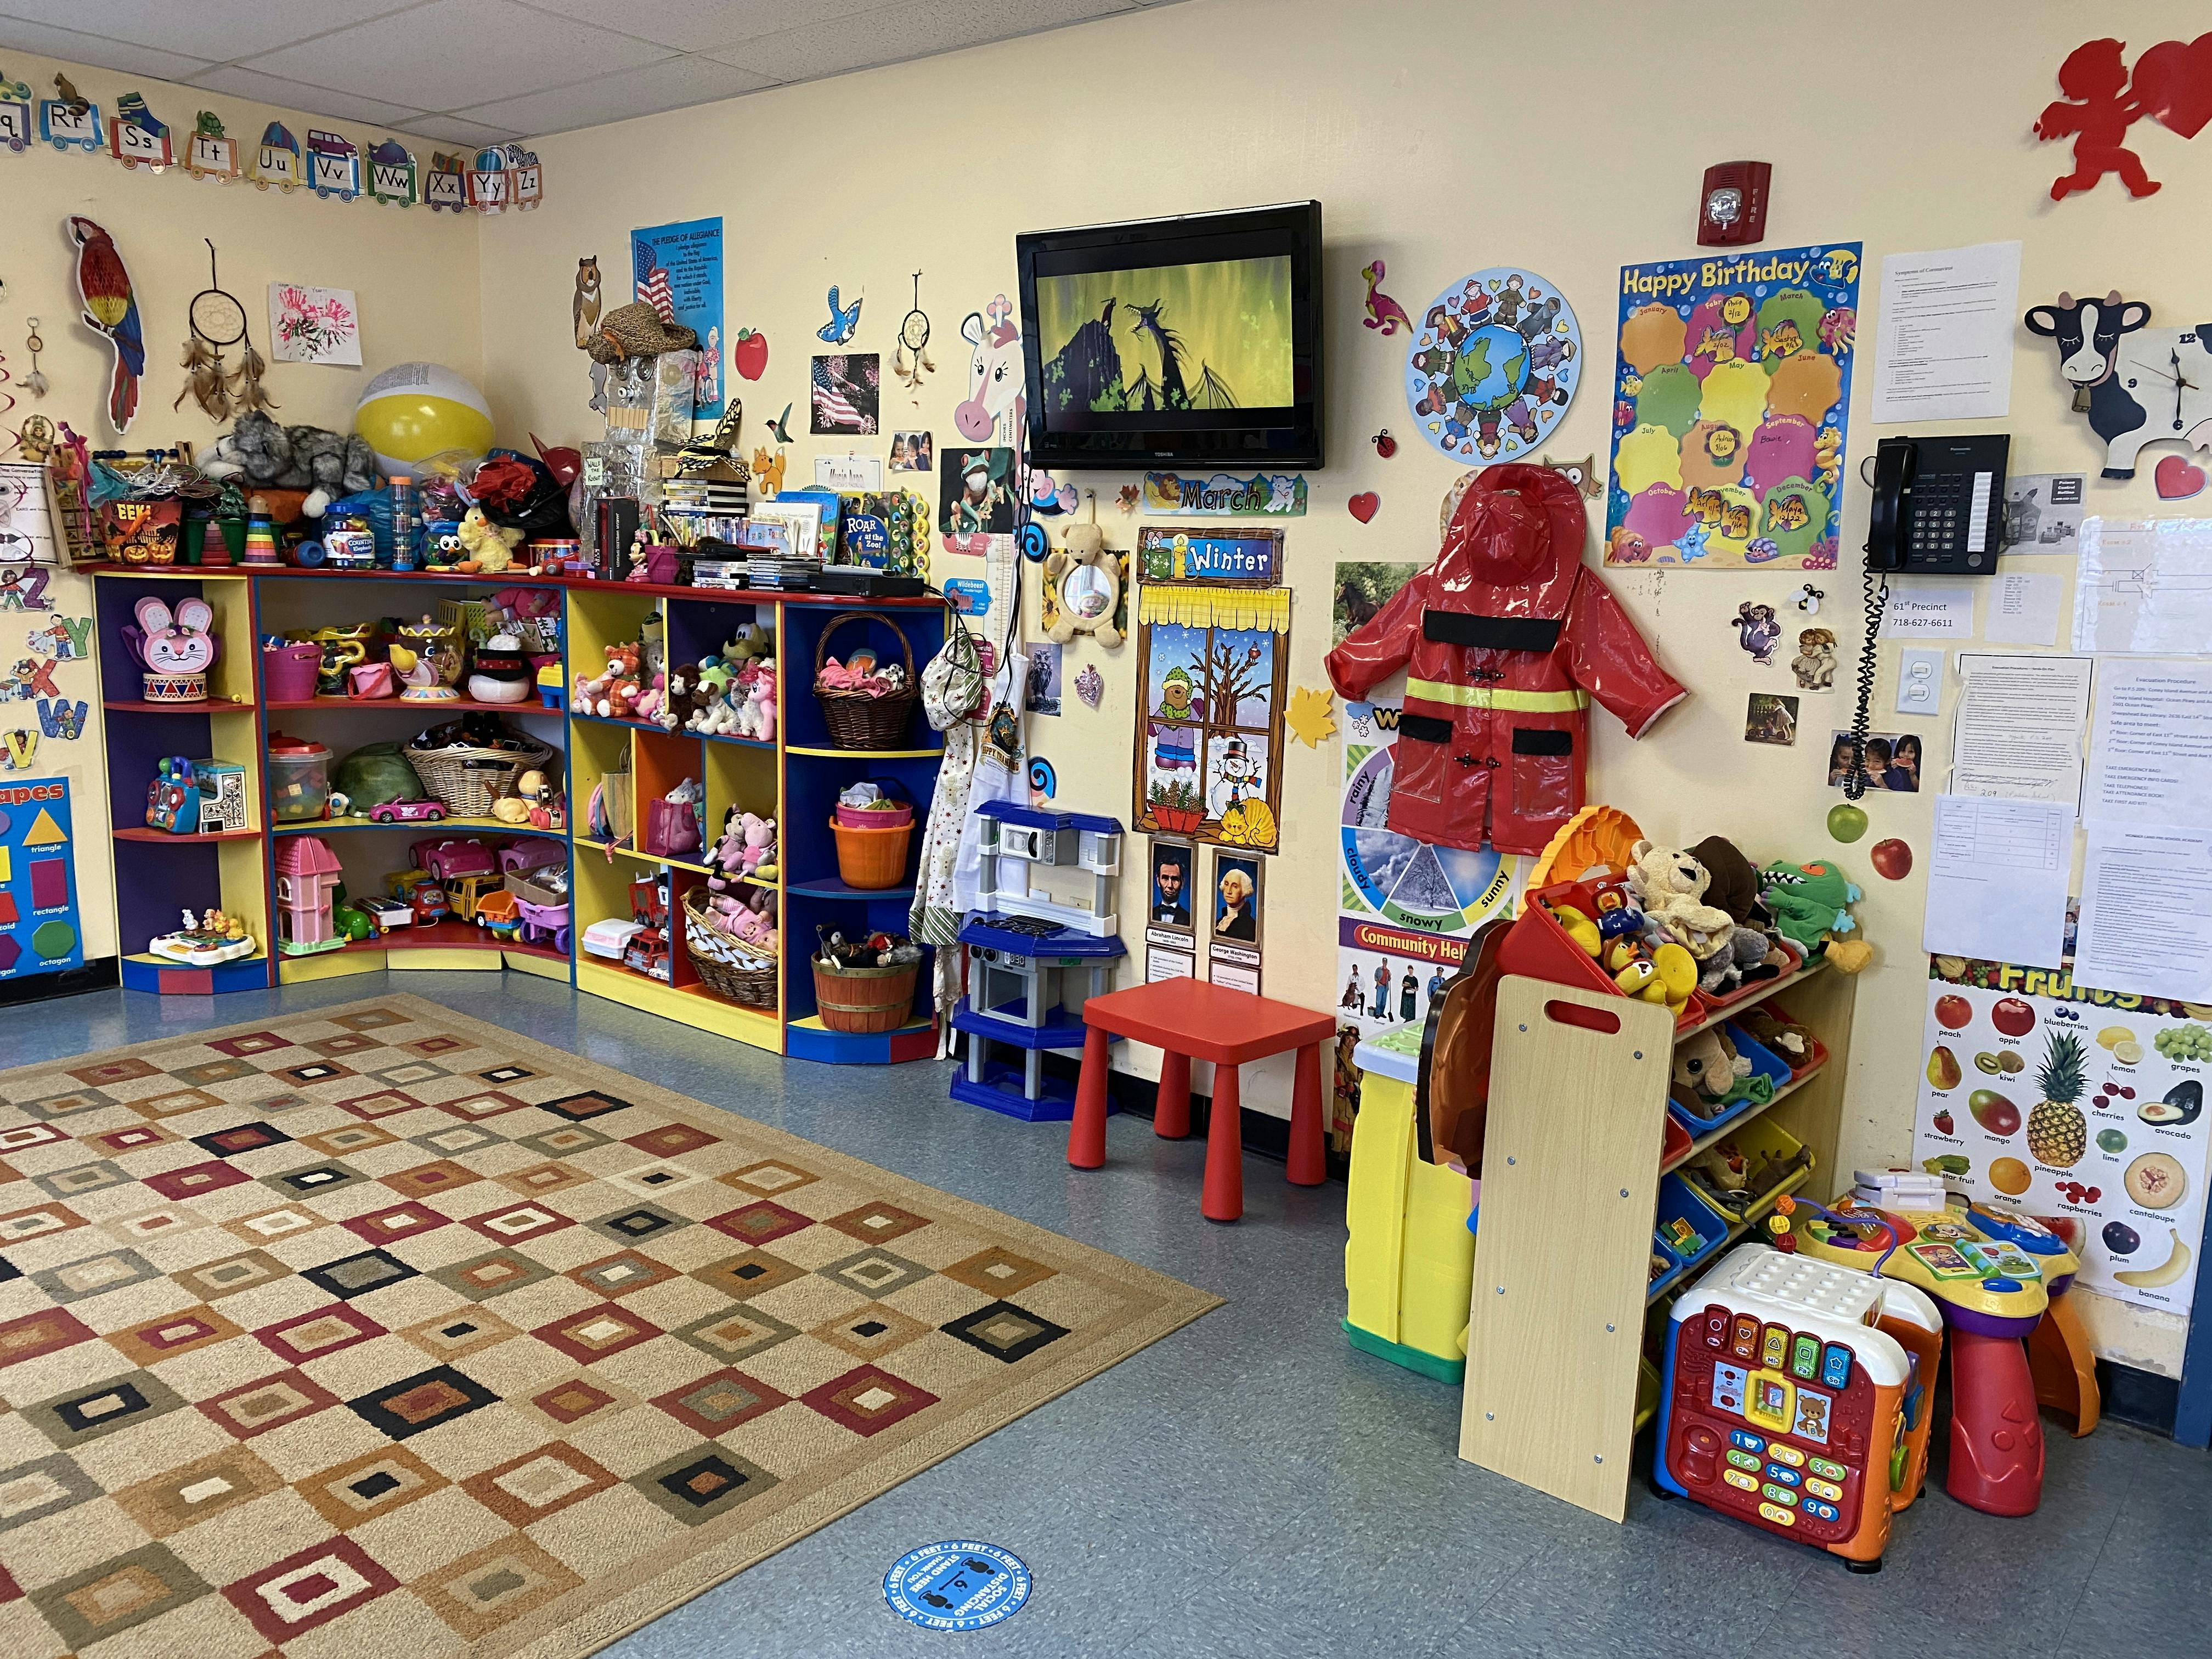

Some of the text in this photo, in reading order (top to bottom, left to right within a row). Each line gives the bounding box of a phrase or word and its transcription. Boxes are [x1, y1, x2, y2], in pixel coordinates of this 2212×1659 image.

[51, 104, 82, 129] Rr
[125, 126, 152, 148] Ss
[197, 137, 220, 161] Tt
[260, 148, 286, 171] Uu
[317, 157, 343, 180] Vv
[374, 166, 408, 188] Ww
[521, 171, 534, 189] Zz
[433, 174, 455, 194] Xx
[476, 174, 500, 200] Yy
[1748, 188, 1758, 223] FIRE
[652, 229, 719, 246] THE PLEDGE OF ALLEGIANCE
[1623, 256, 1809, 297] Happy Birthday
[1780, 292, 1803, 301] March
[1639, 307, 1667, 315] January
[2179, 333, 2196, 344] 12
[2128, 379, 2137, 388] 9
[1765, 417, 1805, 429] September
[2173, 419, 2183, 430] 6
[1641, 427, 1656, 435] July
[1648, 488, 1676, 496] October
[1776, 483, 1813, 493] December
[1181, 481, 1262, 510] March
[847, 517, 877, 533] ROAR
[872, 533, 883, 542] the
[866, 540, 881, 549] Zoo!
[1190, 543, 1267, 571] Winter
[22, 568, 49, 609] Z
[63, 617, 92, 657] Y
[29, 658, 60, 697] X
[37, 699, 88, 739] W
[4, 730, 38, 768] V
[1350, 771, 1370, 804] rainy
[31, 844, 61, 853] triangle
[1347, 847, 1370, 890] cloudy
[1481, 870, 1510, 908] sunny
[33, 905, 69, 916] rectangle
[1400, 913, 1443, 931] snowy
[1151, 931, 1171, 939] Abraham
[1361, 927, 1437, 958] Community
[1212, 946, 1229, 955] George
[1229, 949, 1257, 960] Washington
[39, 957, 71, 967] octagon
[2044, 1018, 2089, 1030] blueberries
[1939, 1029, 1961, 1039] peach
[1999, 1037, 2021, 1046] apple
[2111, 1064, 2136, 1074] lemon
[2171, 1064, 2200, 1074] grapes
[1999, 1074, 2016, 1083] kiwi
[2092, 1110, 2125, 1121] cherries
[1924, 1132, 1965, 1146] strawberry
[1984, 1135, 2010, 1144] mango
[2155, 1128, 2191, 1139] avocado
[2103, 1154, 2119, 1163] lime
[2034, 1165, 2073, 1178] pineapple
[1943, 1173, 1974, 1184] star fruit
[1994, 1194, 2021, 1205] orange
[2057, 1203, 2102, 1217] raspberries
[2129, 1207, 2175, 1223] cantaloupe
[2109, 1254, 2129, 1264] plum
[2138, 1289, 2170, 1302] banana
[1735, 1434, 1740, 1444] 1
[1732, 1454, 1740, 1464] 4
[1773, 1448, 1782, 1459] 2
[1770, 1466, 1779, 1477] 5
[1813, 1461, 1822, 1472] 3
[1728, 1472, 1736, 1483] 7
[1768, 1487, 1776, 1498] 8
[1811, 1482, 1820, 1493] 6
[1764, 1506, 1774, 1518] 0
[1808, 1502, 1816, 1513] 9
[917, 1544, 941, 1557] FEET
[961, 1543, 989, 1552] FEET
[907, 1555, 945, 1583] THANK YOU
[1000, 1554, 1022, 1571] FEET
[890, 1565, 906, 1582] FEET
[909, 1554, 960, 1593] STAND HERE
[954, 1572, 1009, 1616] DISTANCING
[973, 1585, 1007, 1611] SOCIAL
[1013, 1582, 1027, 1601] FEET
[890, 1595, 911, 1613] FEET
[925, 1617, 964, 1628] 6 FEET
[978, 1610, 1005, 1625] FEET
